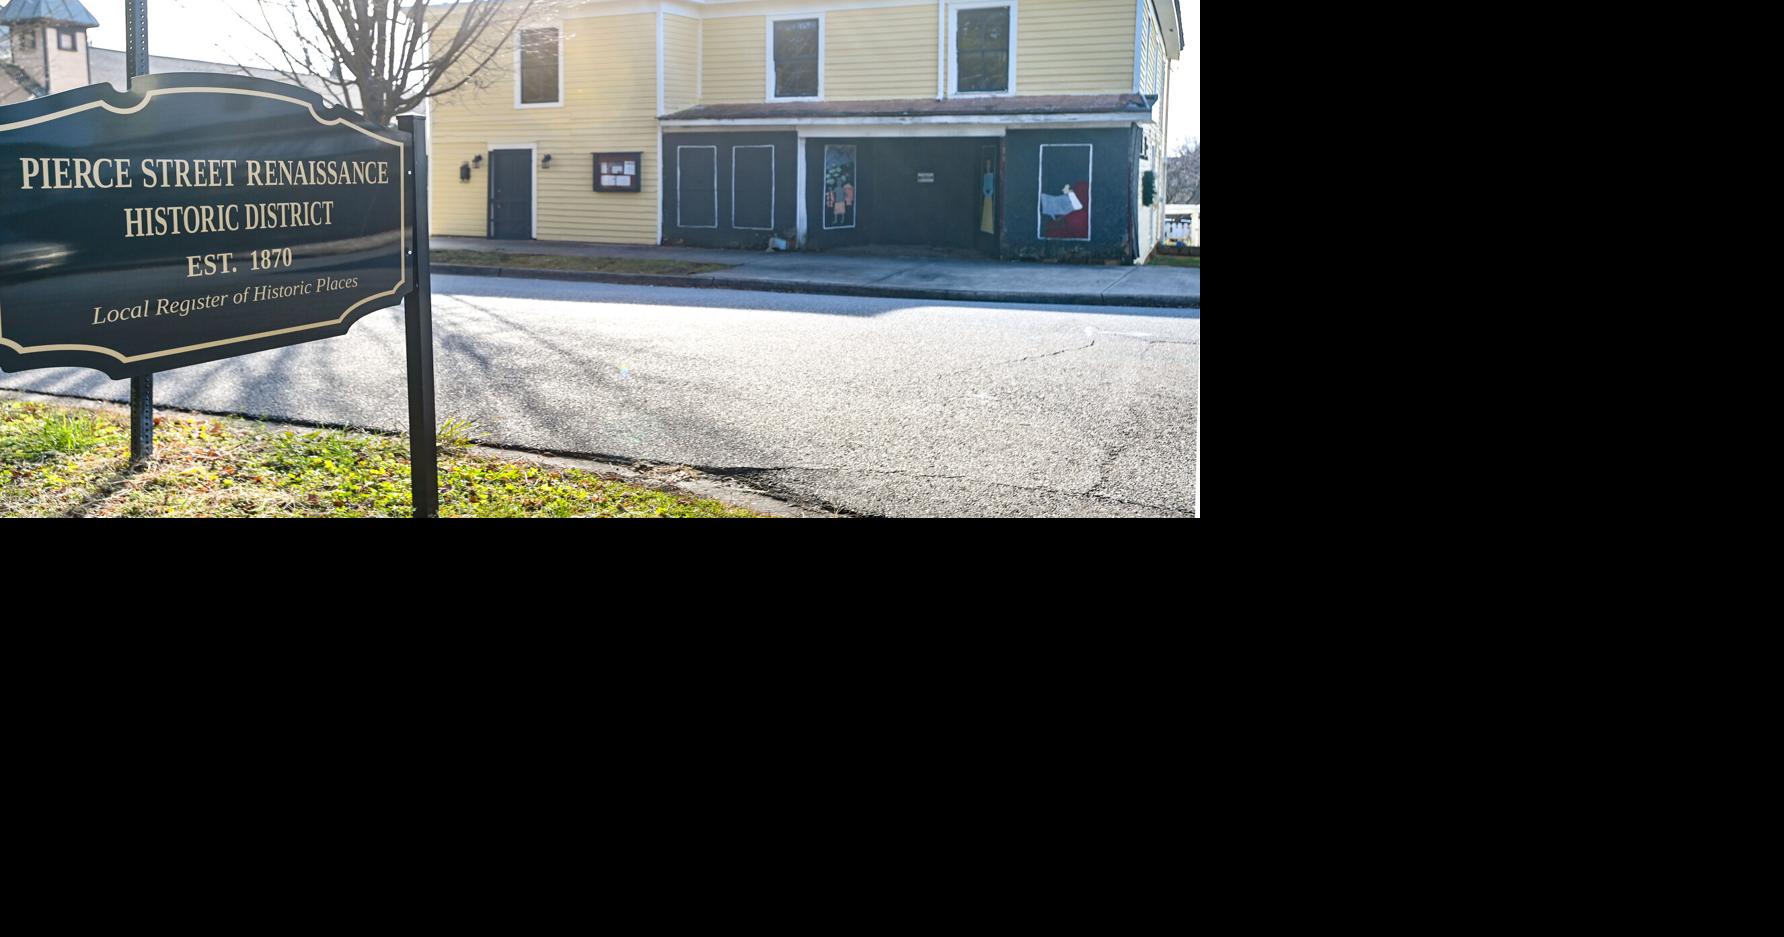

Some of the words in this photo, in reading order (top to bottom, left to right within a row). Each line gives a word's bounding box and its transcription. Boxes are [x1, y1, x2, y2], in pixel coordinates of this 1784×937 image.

[20, 157, 132, 189] PIERCE
[142, 159, 237, 188] STREET
[246, 160, 389, 186] RENAISSANCE
[124, 205, 239, 237] HISTORIC
[244, 201, 334, 230] DISTRICT
[186, 252, 237, 278] EST.
[250, 247, 293, 271] 1870
[91, 300, 149, 325] Local
[155, 293, 229, 317] Register
[233, 287, 251, 305] of
[253, 281, 312, 302] Historic
[315, 275, 359, 293] Places
